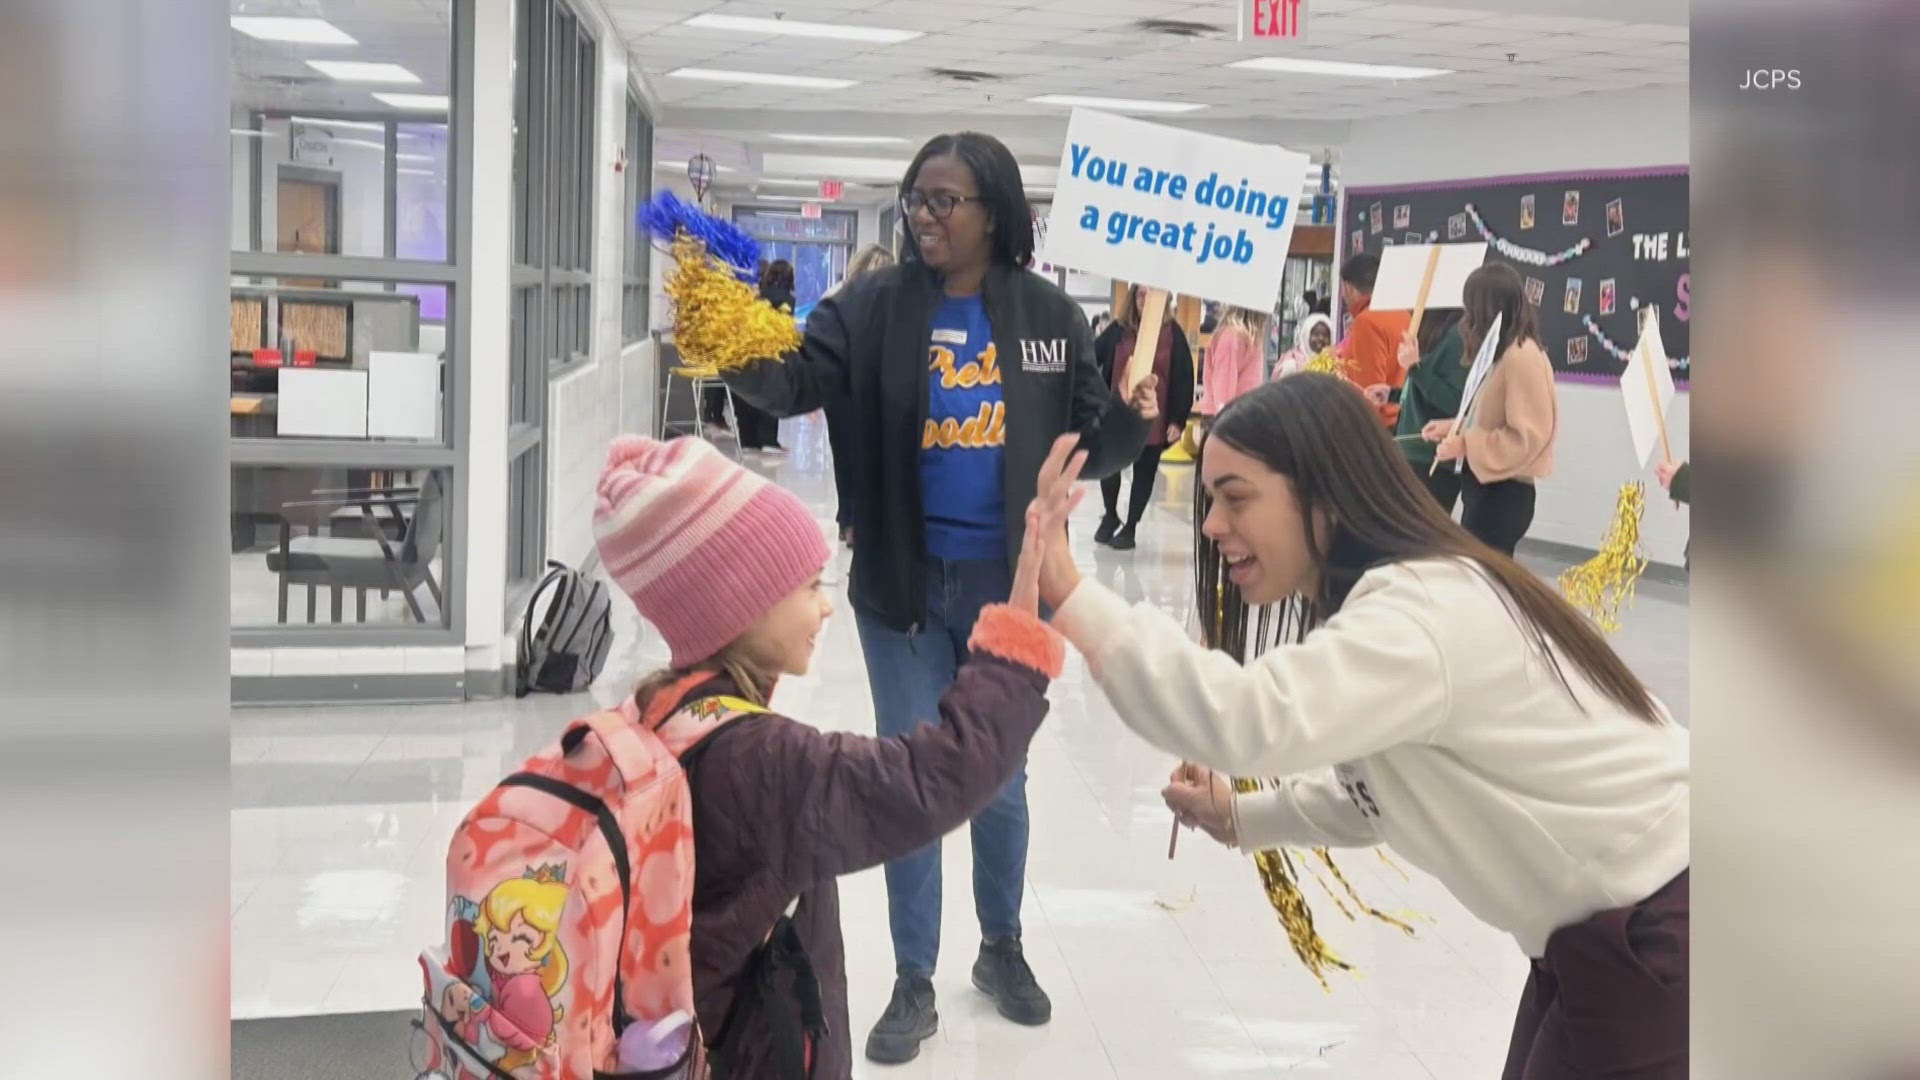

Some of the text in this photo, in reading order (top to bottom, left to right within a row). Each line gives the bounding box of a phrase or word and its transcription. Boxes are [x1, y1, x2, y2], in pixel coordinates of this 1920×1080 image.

[1253, 0, 1300, 36] EXIT
[1071, 143, 1289, 230] You are doing
[1080, 205, 1254, 265] a great job
[1632, 232, 1690, 261] THE L
[1019, 339, 1067, 363] HMI
